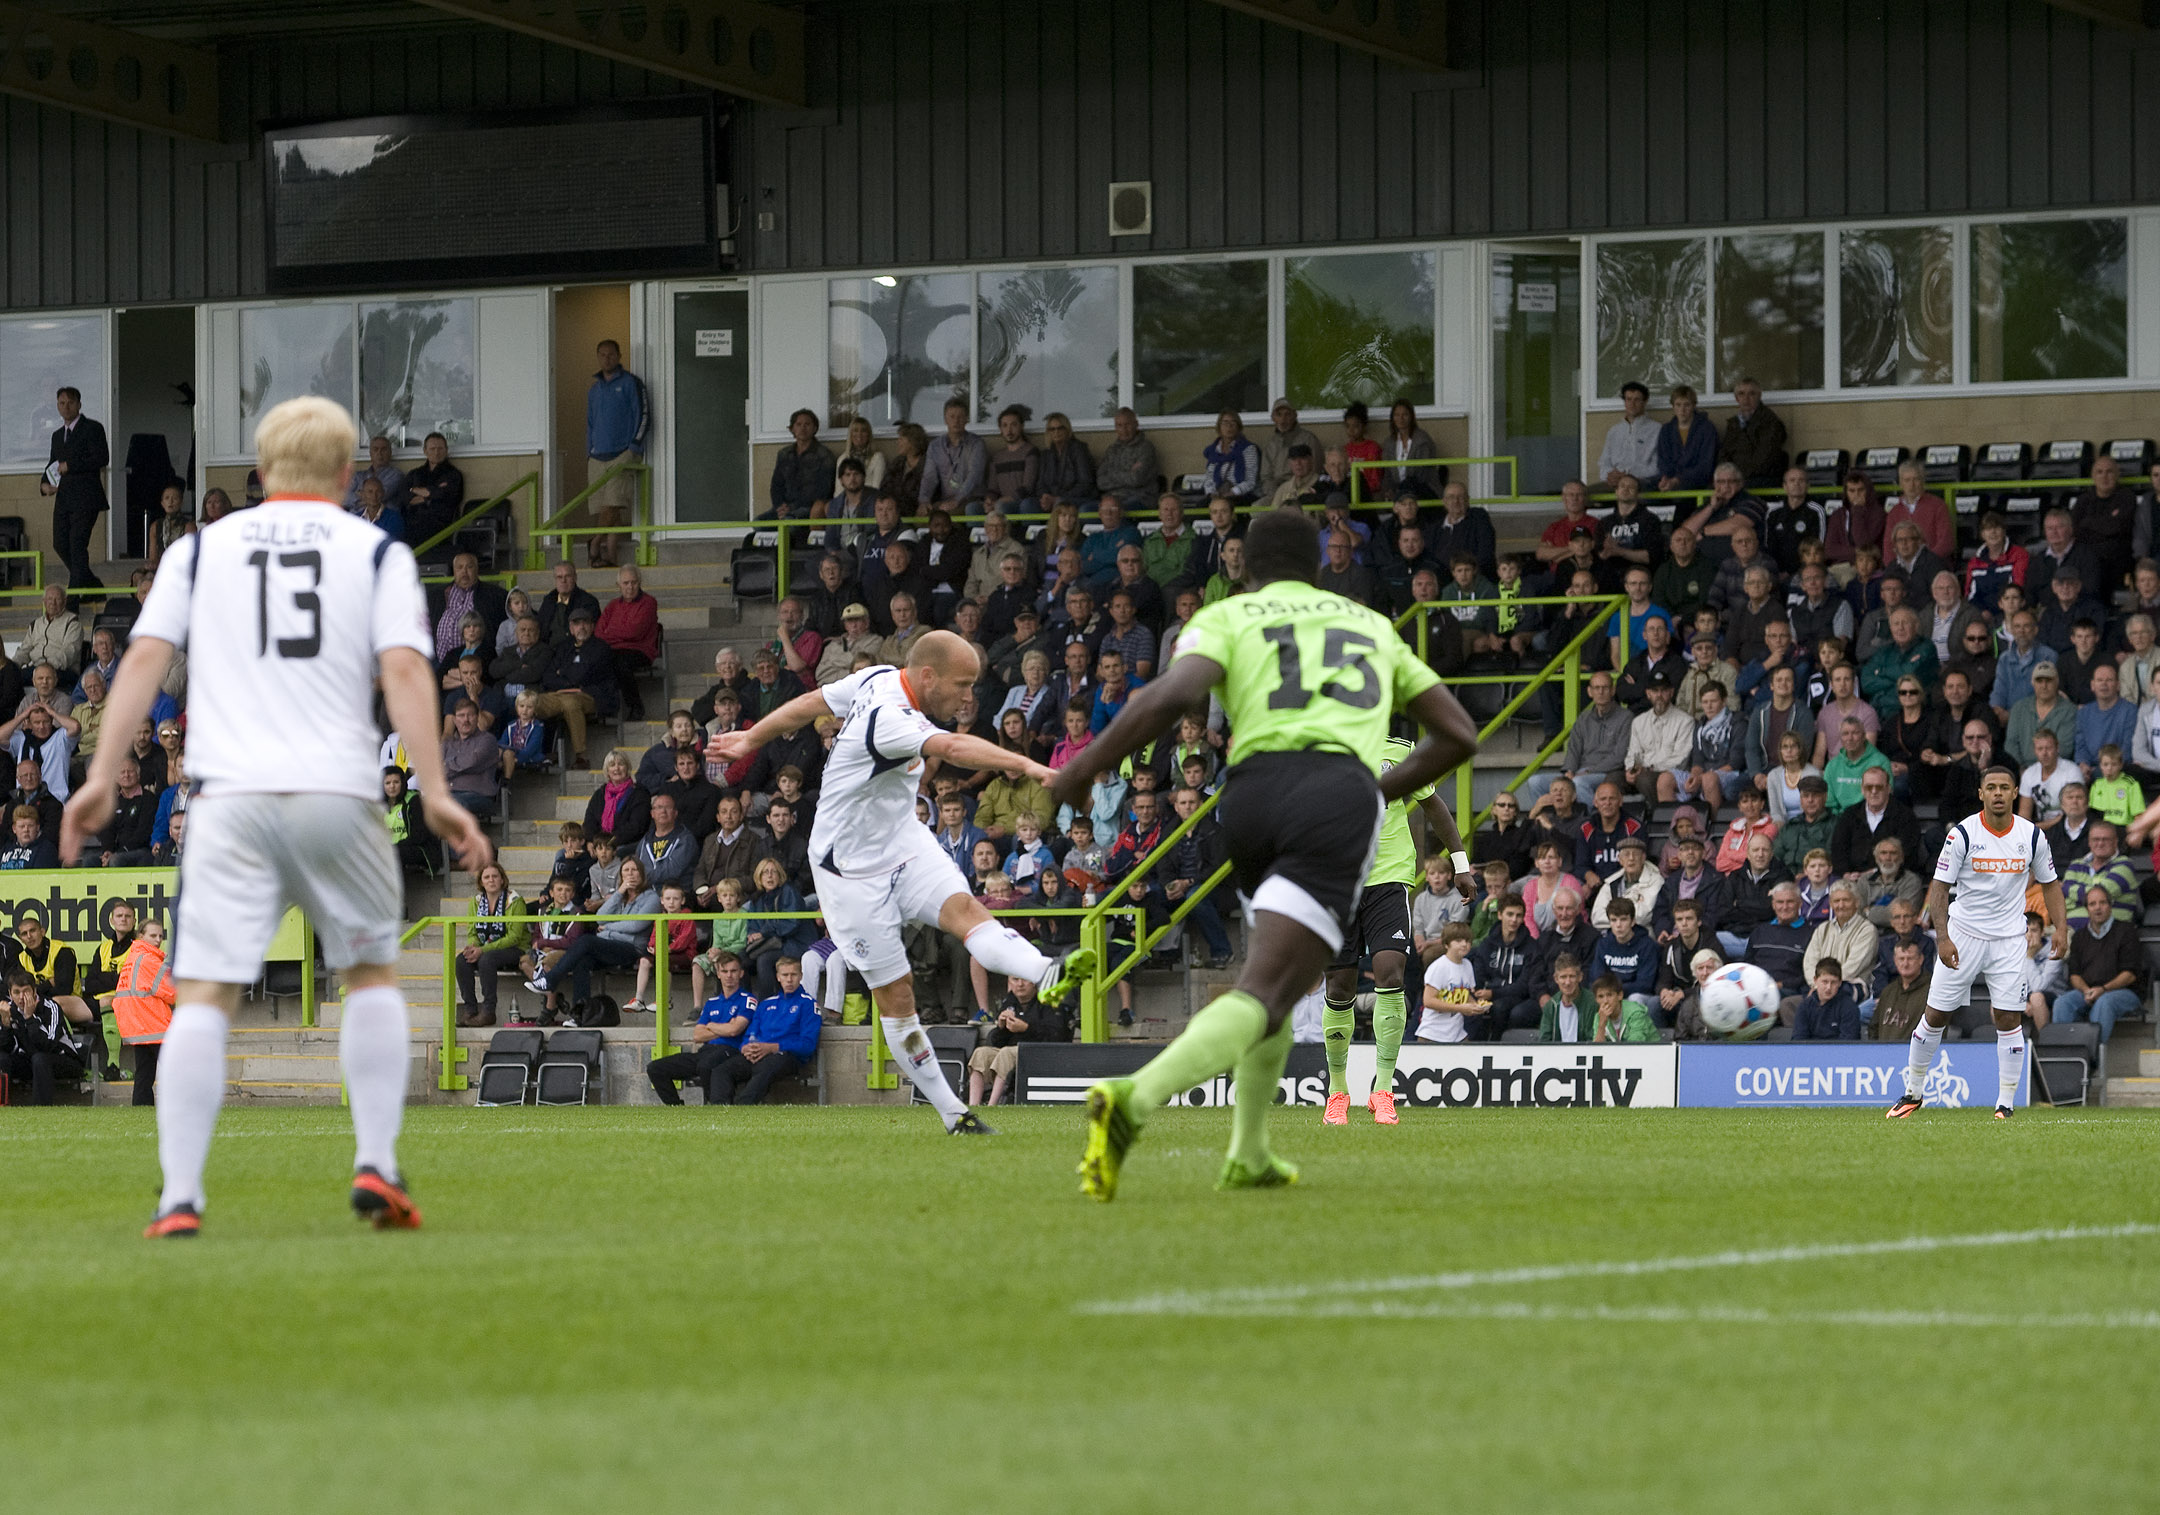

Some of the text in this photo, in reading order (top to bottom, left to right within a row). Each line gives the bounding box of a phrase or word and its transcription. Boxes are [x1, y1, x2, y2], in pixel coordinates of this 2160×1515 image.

[247, 550, 322, 658] 13
[1262, 623, 1381, 710] 15
[1973, 860, 2025, 872] easyJet
[1735, 1067, 1895, 1096] COVENTRY
